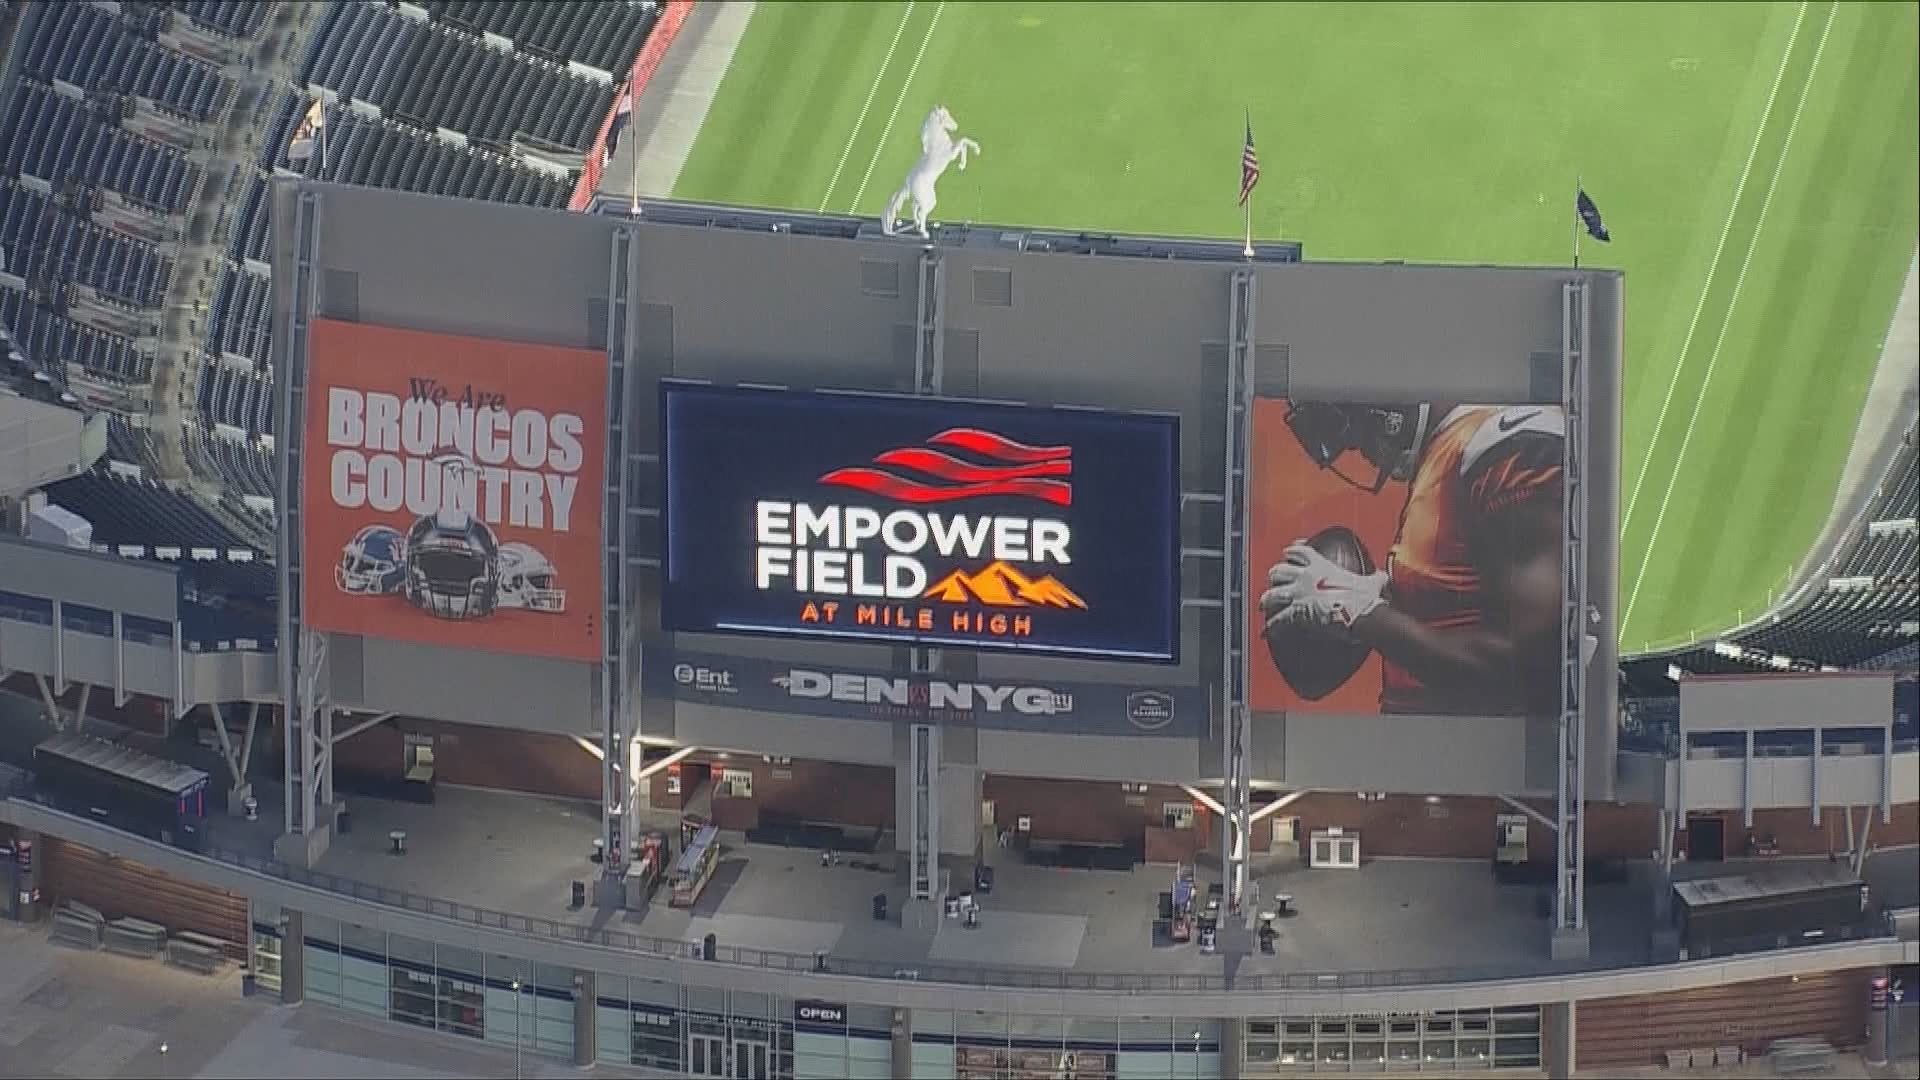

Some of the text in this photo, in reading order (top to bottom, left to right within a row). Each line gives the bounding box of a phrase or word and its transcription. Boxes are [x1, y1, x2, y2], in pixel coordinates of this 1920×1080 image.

[409, 377, 506, 412] We Are
[327, 386, 584, 473] BRONCOS
[330, 450, 579, 532] COUNTRY
[756, 500, 1072, 565] EMPOWER
[756, 546, 928, 599] FIELD
[800, 601, 1032, 637] AT MILE HIGH
[696, 667, 734, 685] Ent
[789, 668, 909, 705] DEN
[928, 681, 1055, 714] NYG
[799, 1007, 842, 1021] OPEN
